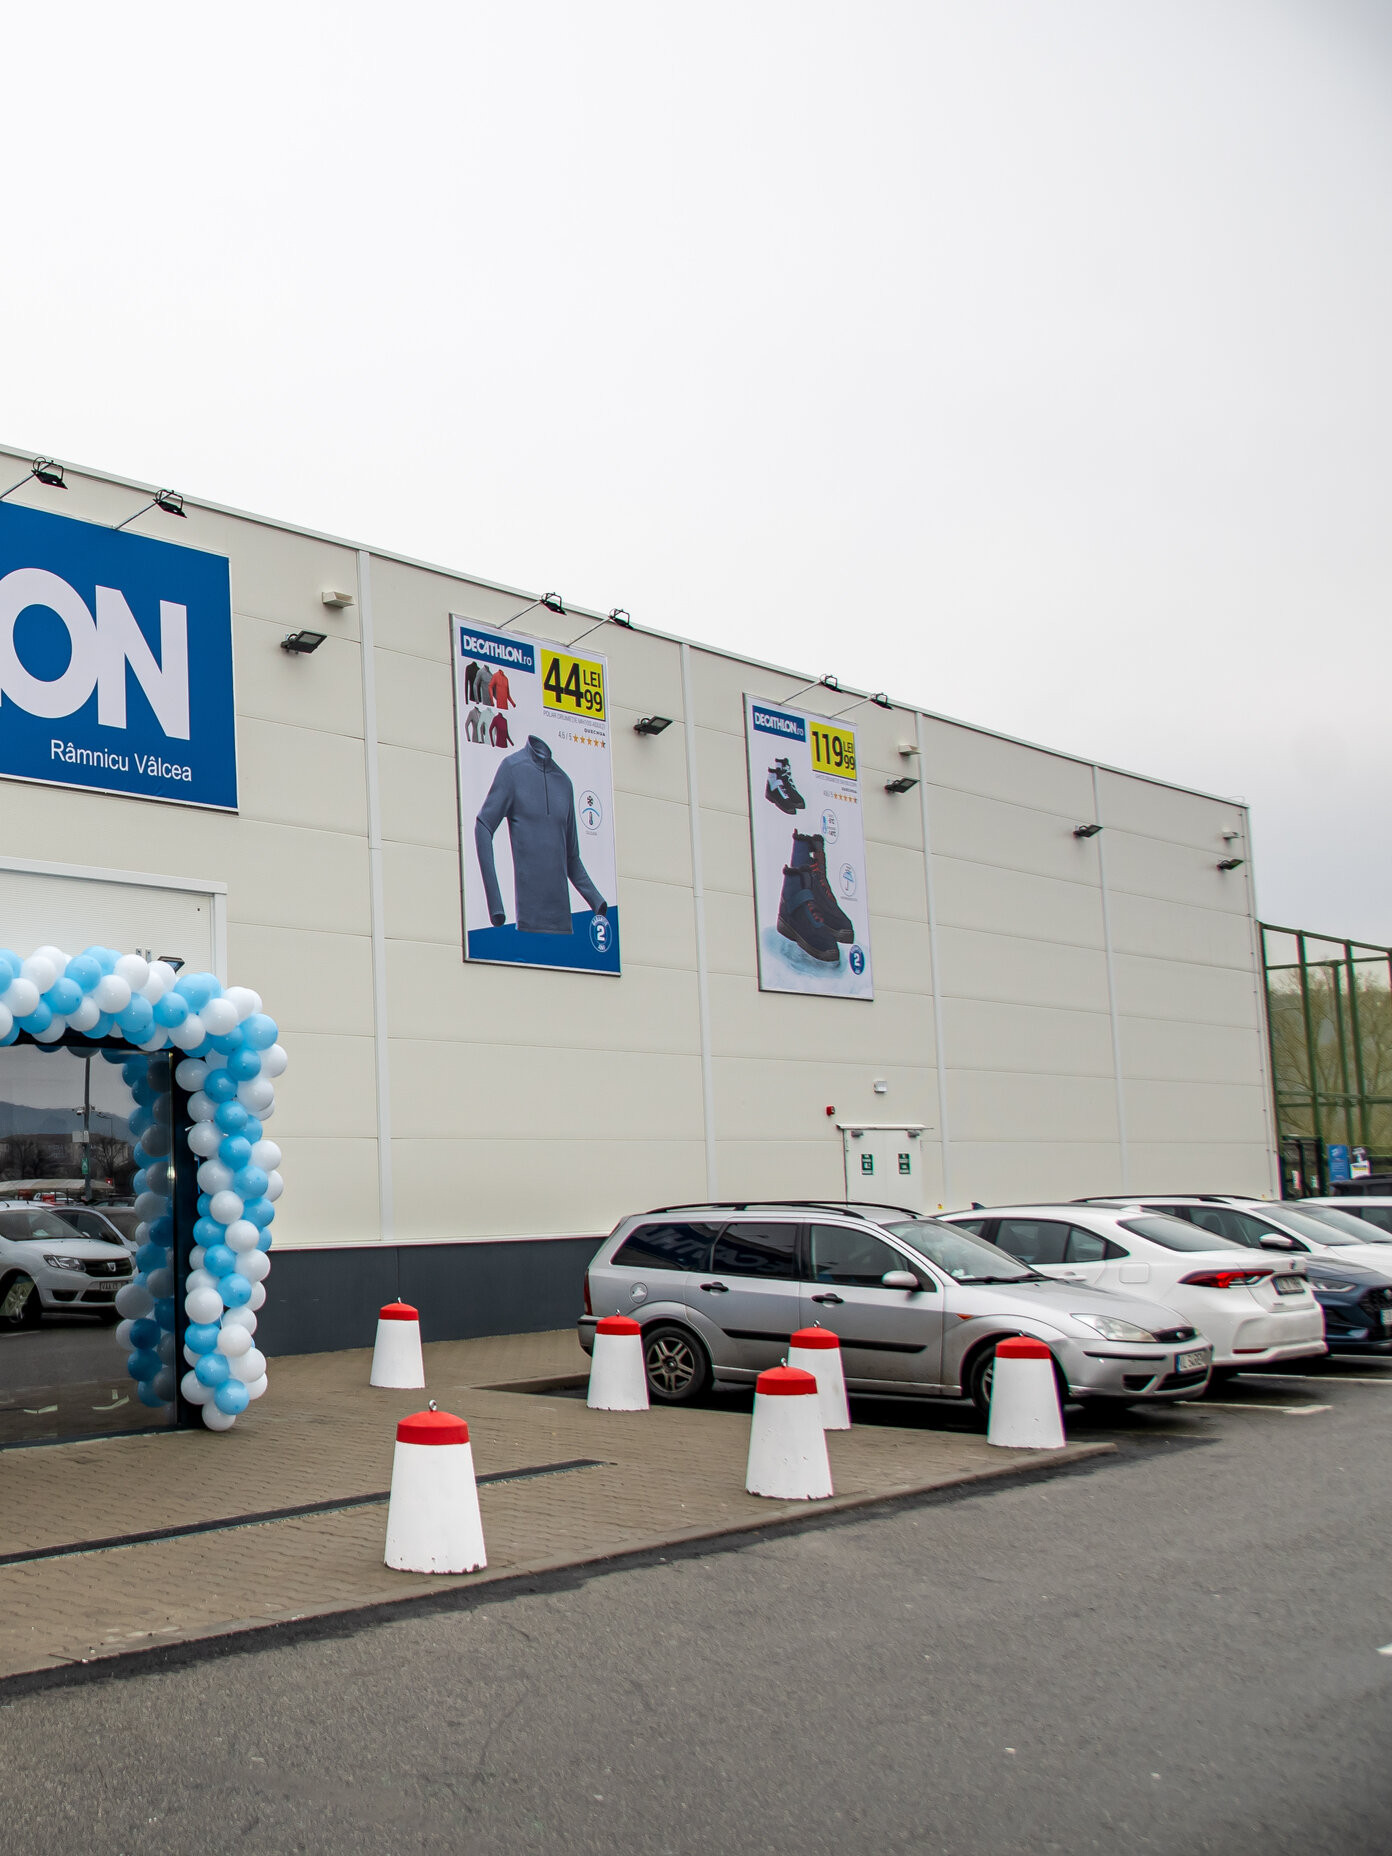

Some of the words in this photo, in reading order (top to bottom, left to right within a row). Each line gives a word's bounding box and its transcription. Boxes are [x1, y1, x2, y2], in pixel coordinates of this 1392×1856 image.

[463, 634, 533, 666] DECATHLON.ro
[543, 657, 584, 708] 44
[583, 669, 601, 689] LEI
[584, 689, 603, 713] 99
[811, 730, 843, 768] 119
[843, 741, 854, 754] LEI
[50, 739, 129, 772] Râmnicu
[134, 753, 192, 782] Vâlcea
[843, 754, 856, 771] 99
[596, 924, 606, 942] 2
[854, 952, 861, 967] 2
